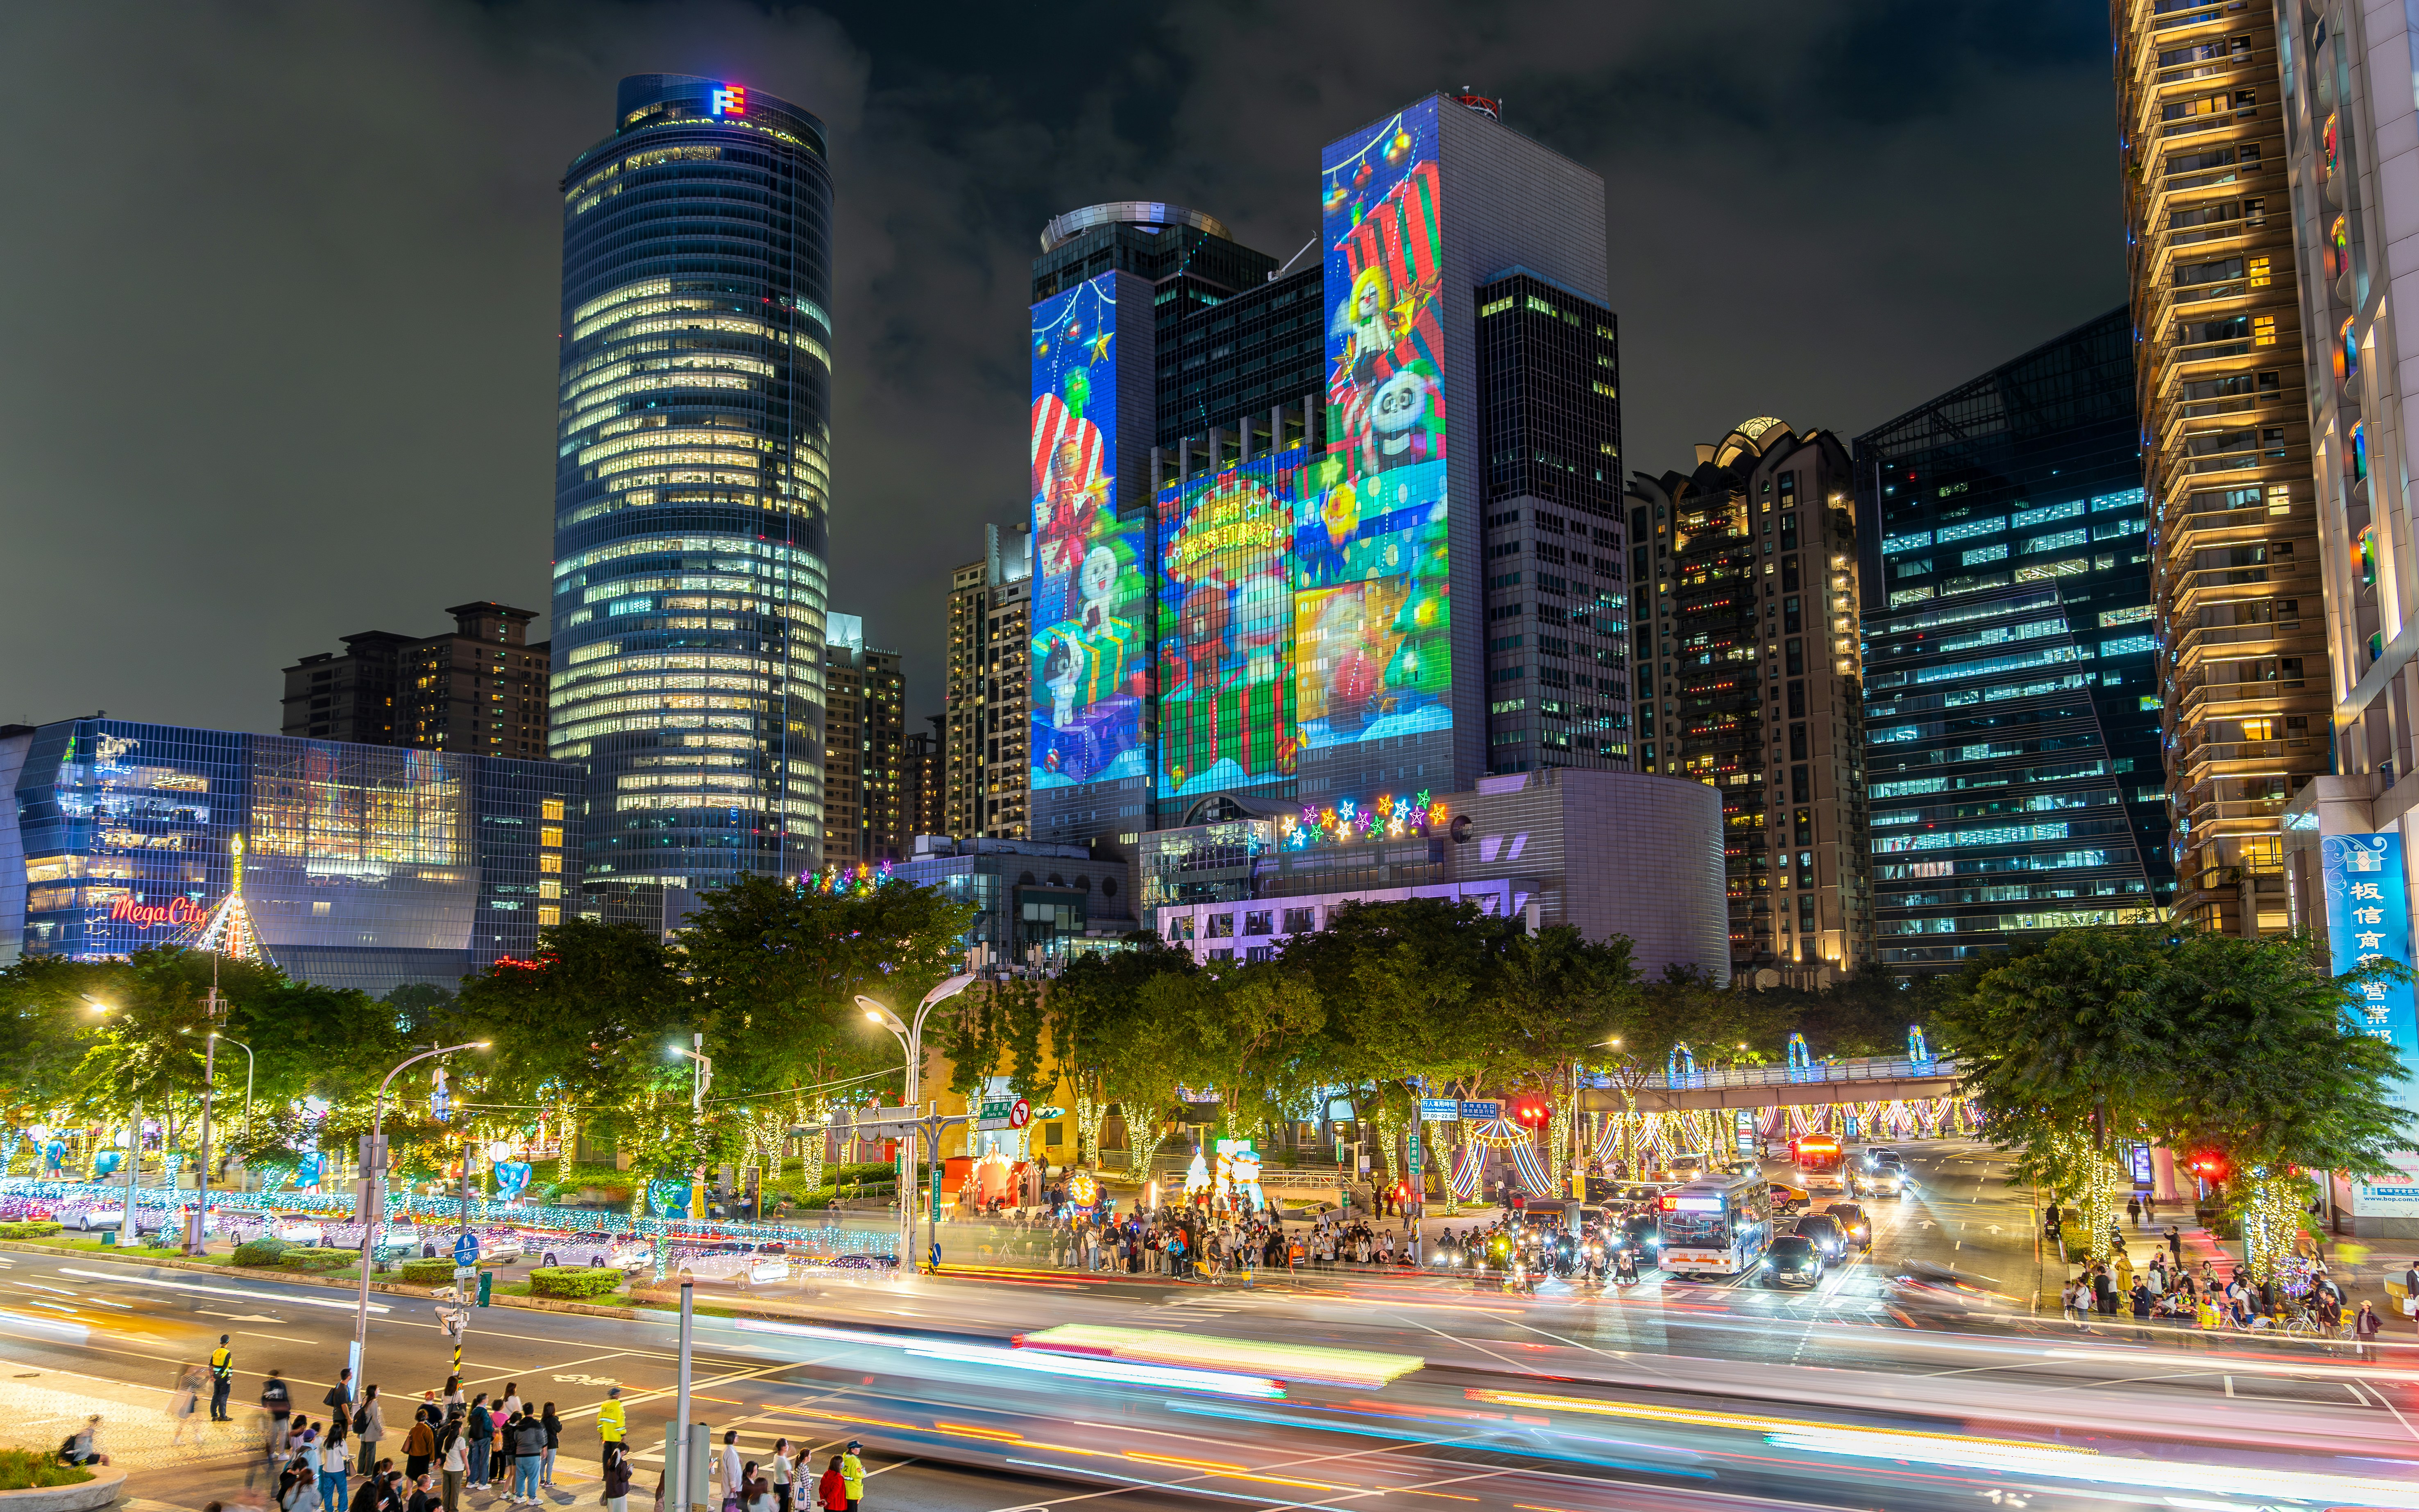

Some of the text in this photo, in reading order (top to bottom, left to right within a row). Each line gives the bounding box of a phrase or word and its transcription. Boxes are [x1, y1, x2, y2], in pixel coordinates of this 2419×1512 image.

[1213, 501, 1240, 525] 新北
[1183, 521, 1276, 564] 歡樂耶誕城
[109, 894, 208, 932] Mega City
[984, 1103, 1008, 1112] 新府路
